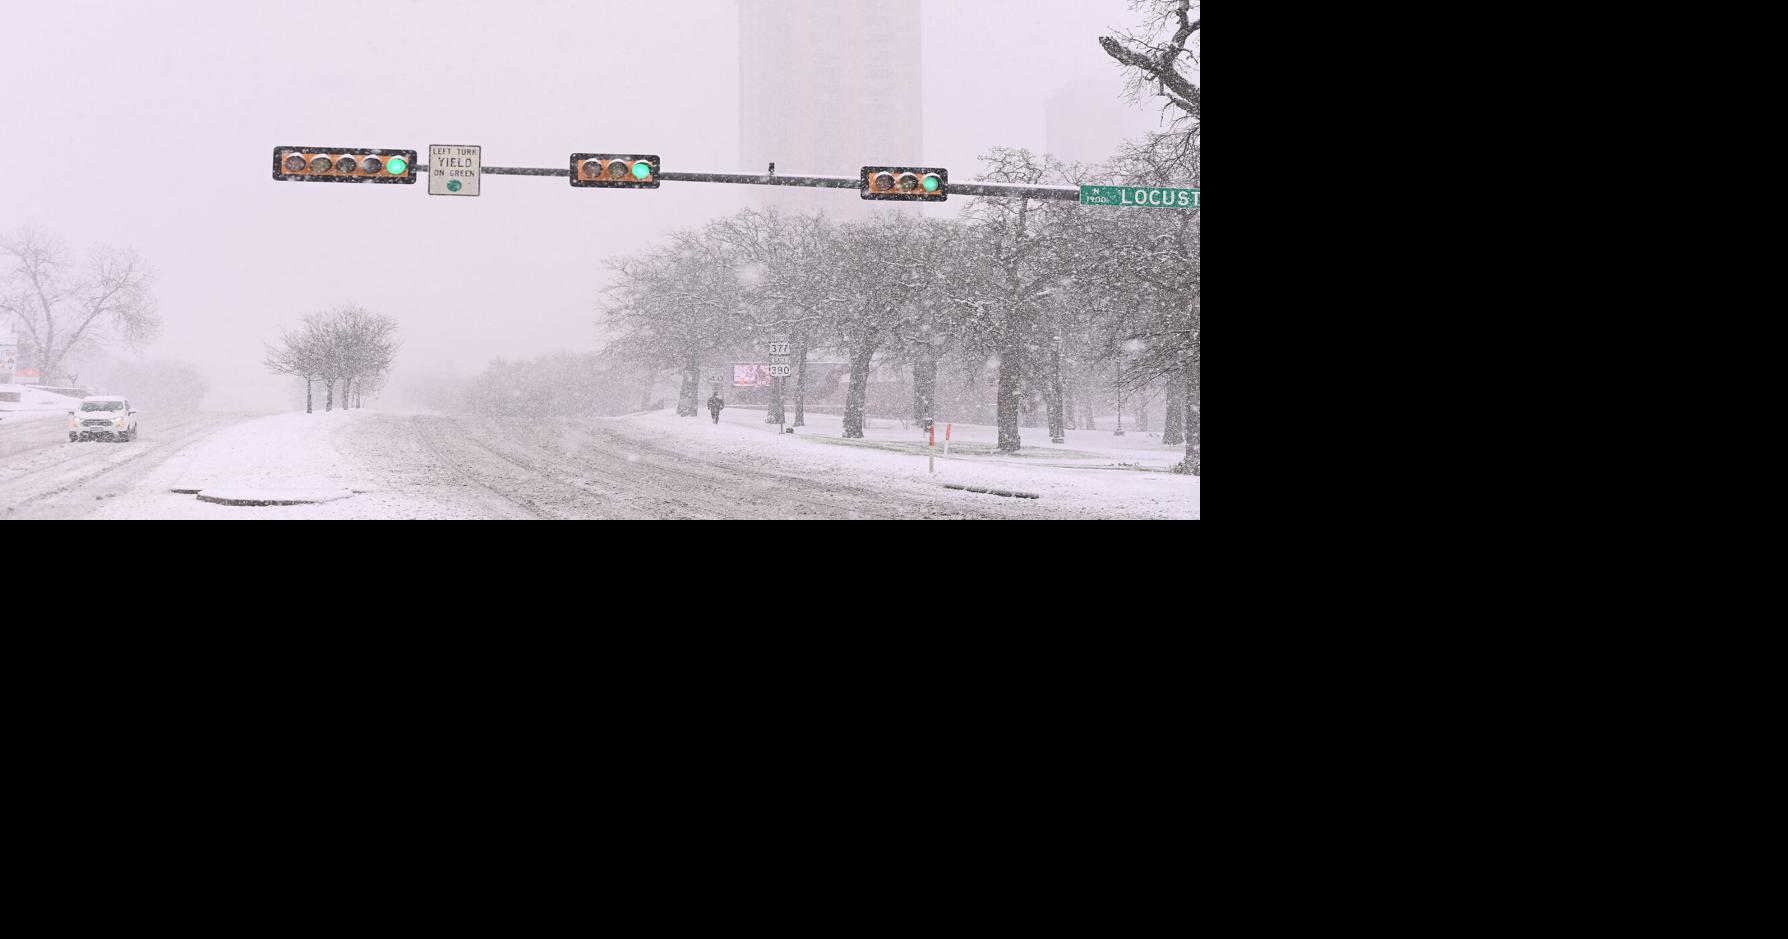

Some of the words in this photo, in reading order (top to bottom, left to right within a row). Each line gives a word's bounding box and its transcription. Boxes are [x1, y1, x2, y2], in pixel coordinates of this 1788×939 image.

[433, 147, 451, 155] LEFT
[457, 148, 477, 156] TURN
[438, 157, 472, 167] YIELD
[1121, 189, 1200, 206] LOCUST
[772, 345, 788, 353] 377
[771, 366, 790, 374] 380
